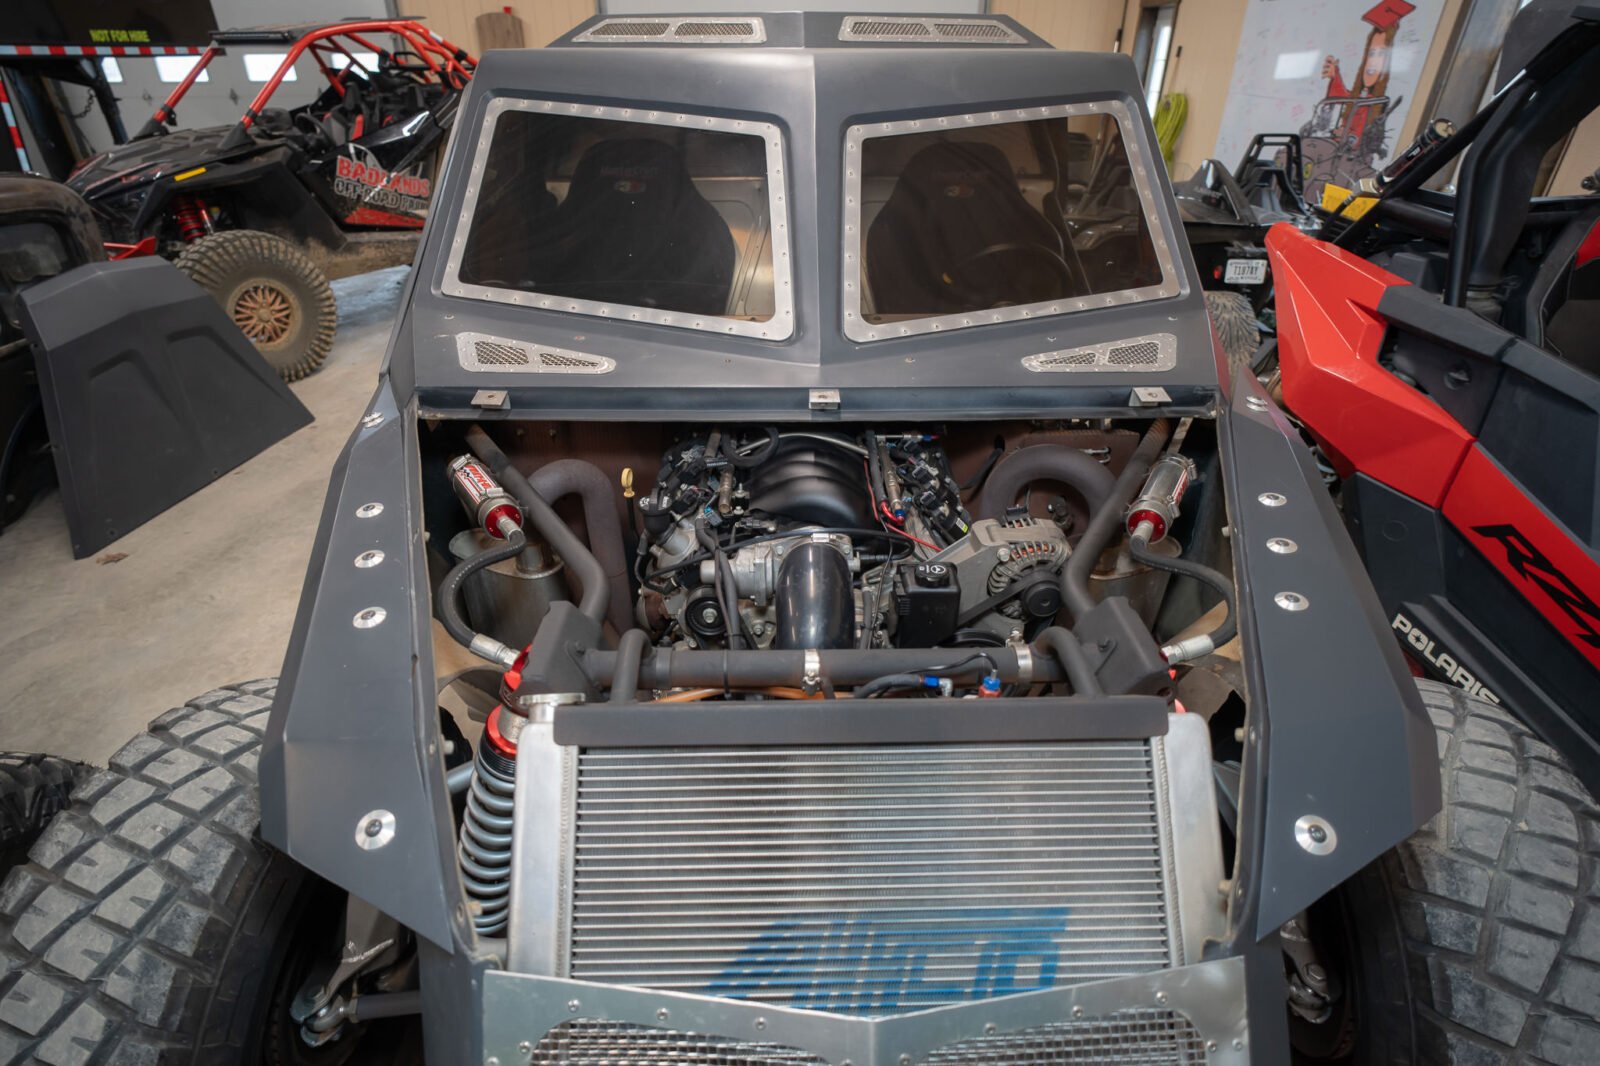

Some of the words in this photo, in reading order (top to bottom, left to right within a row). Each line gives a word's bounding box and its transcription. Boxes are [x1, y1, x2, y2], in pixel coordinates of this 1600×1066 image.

[89, 29, 110, 42] NOT
[110, 30, 130, 42] FOR
[128, 30, 150, 42] HIRE
[1468, 524, 1600, 648] RZ
[1391, 613, 1500, 704] POLARIS
